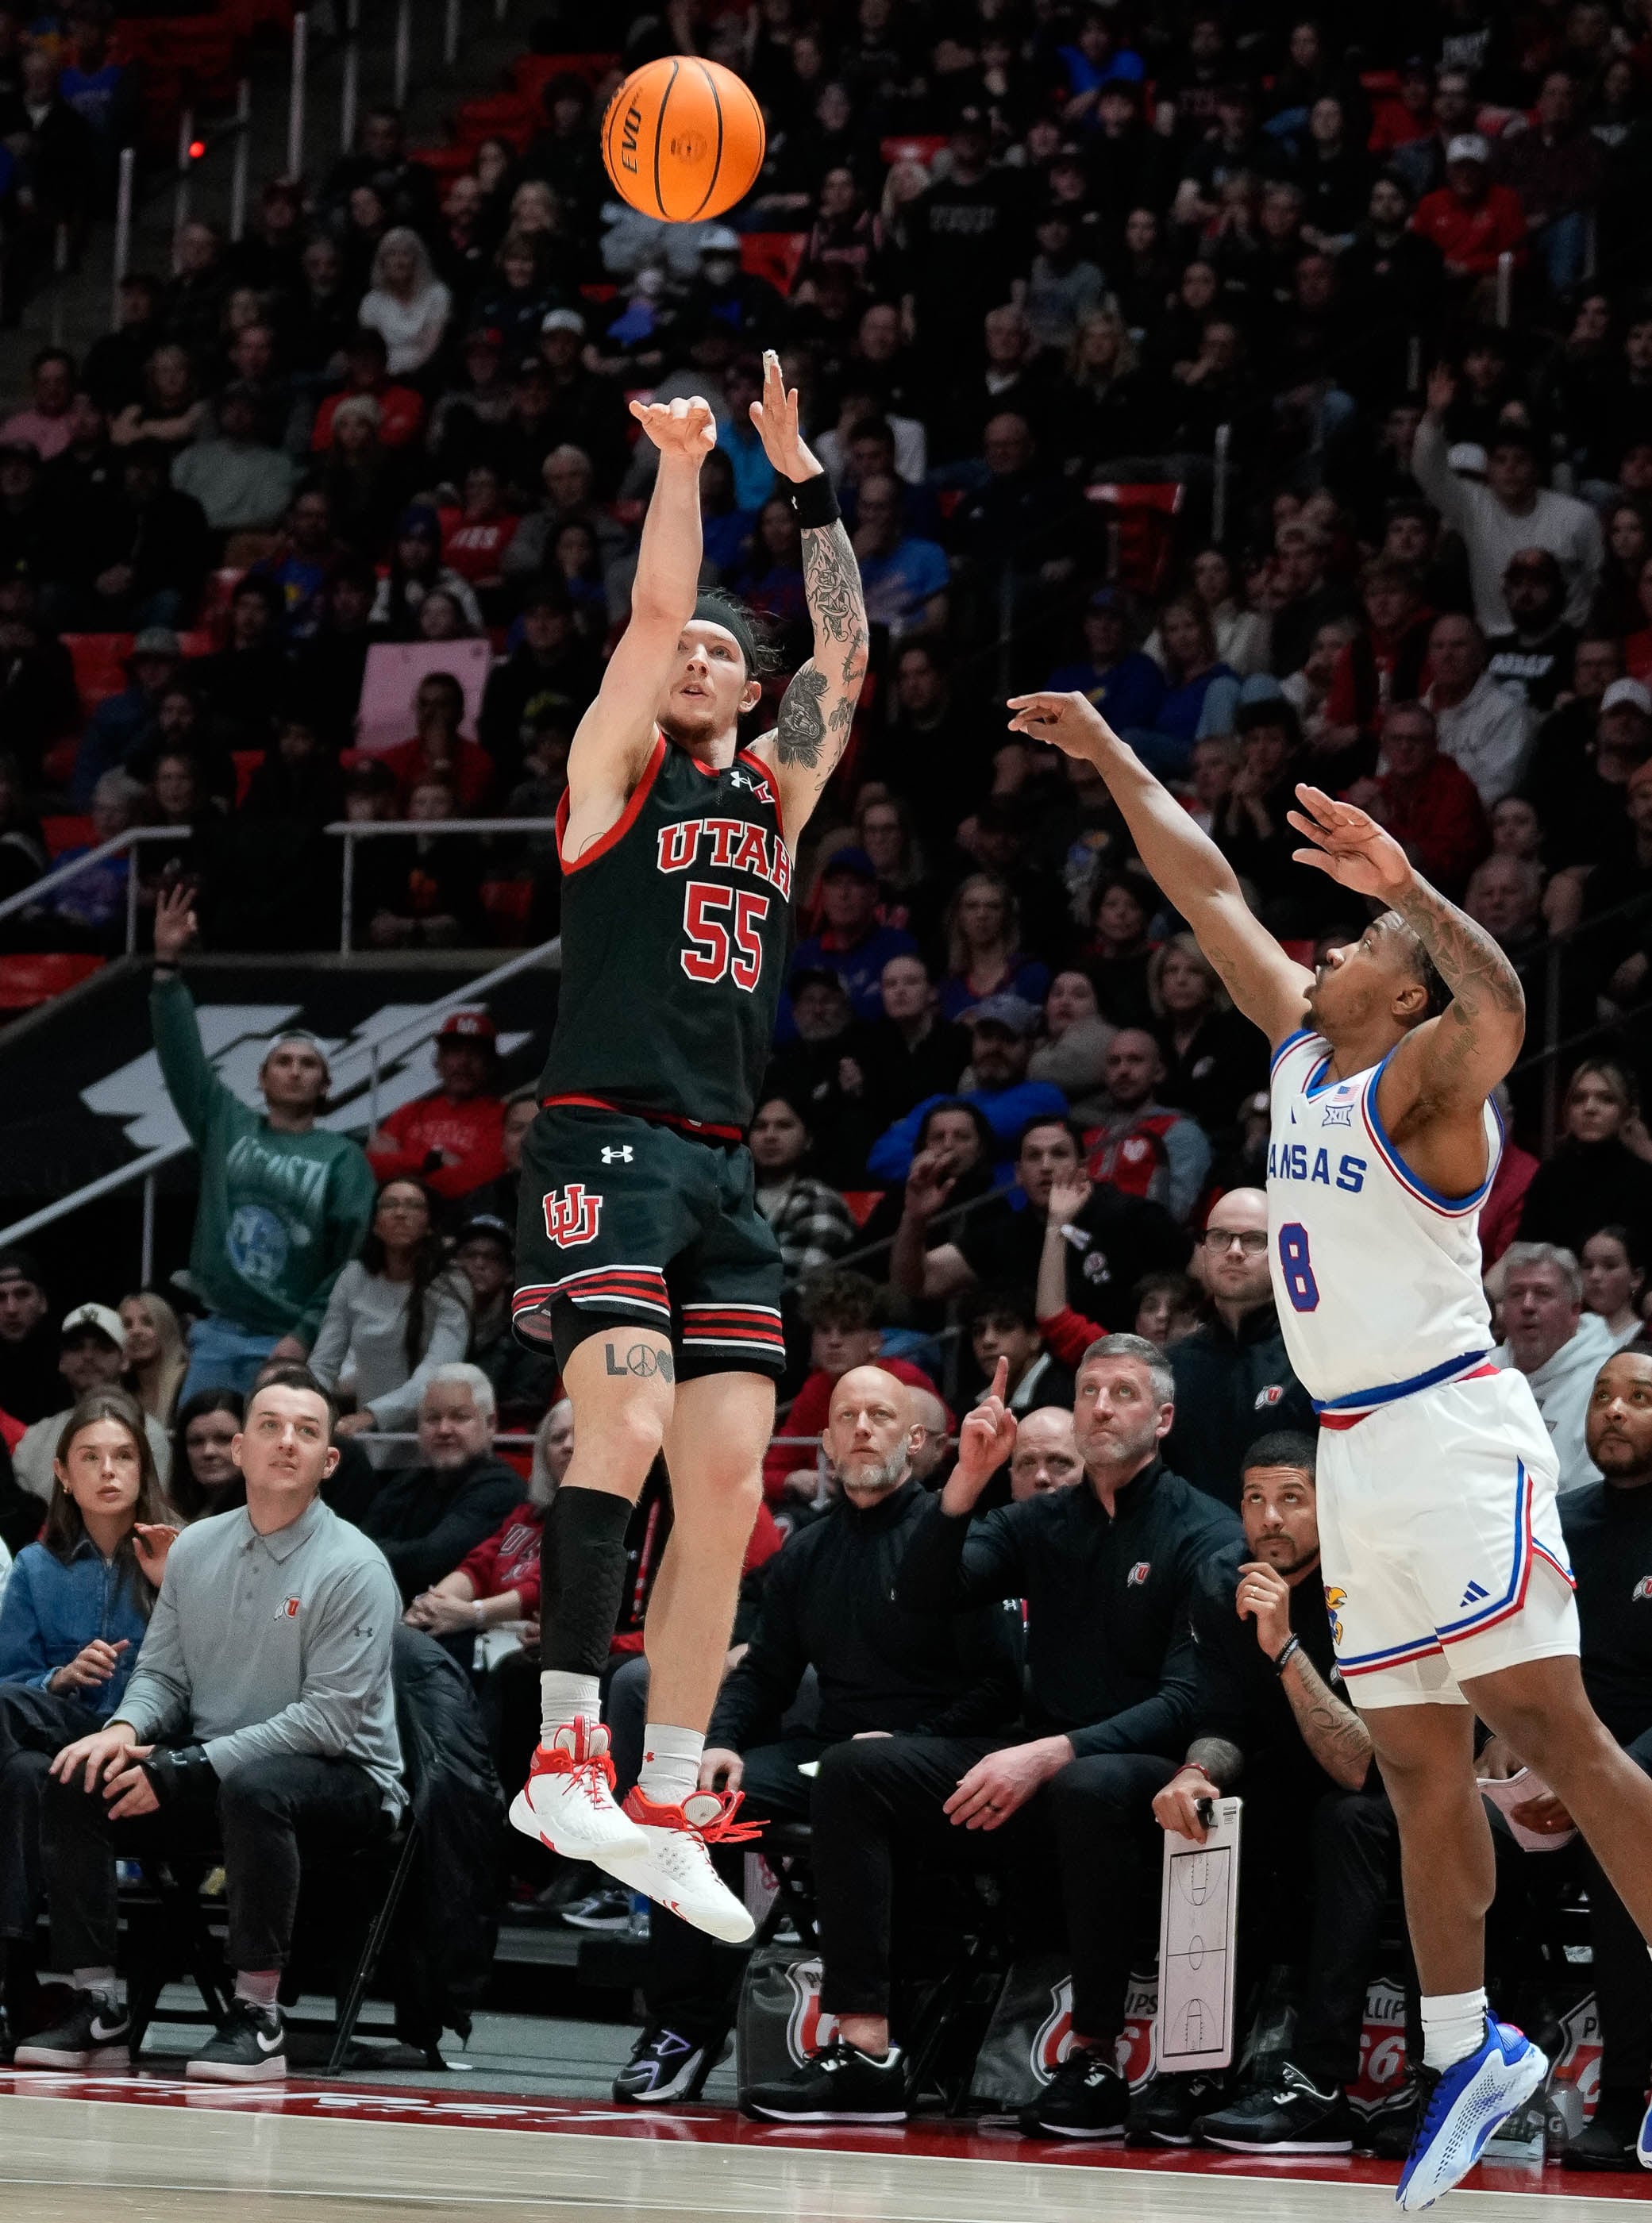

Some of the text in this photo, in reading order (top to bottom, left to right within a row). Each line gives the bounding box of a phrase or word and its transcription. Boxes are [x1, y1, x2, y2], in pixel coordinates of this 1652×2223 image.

[657, 818, 791, 903] UTAH
[680, 880, 770, 993] 55
[1269, 1143, 1368, 1193] ANSAS
[1278, 1223, 1320, 1312] 8
